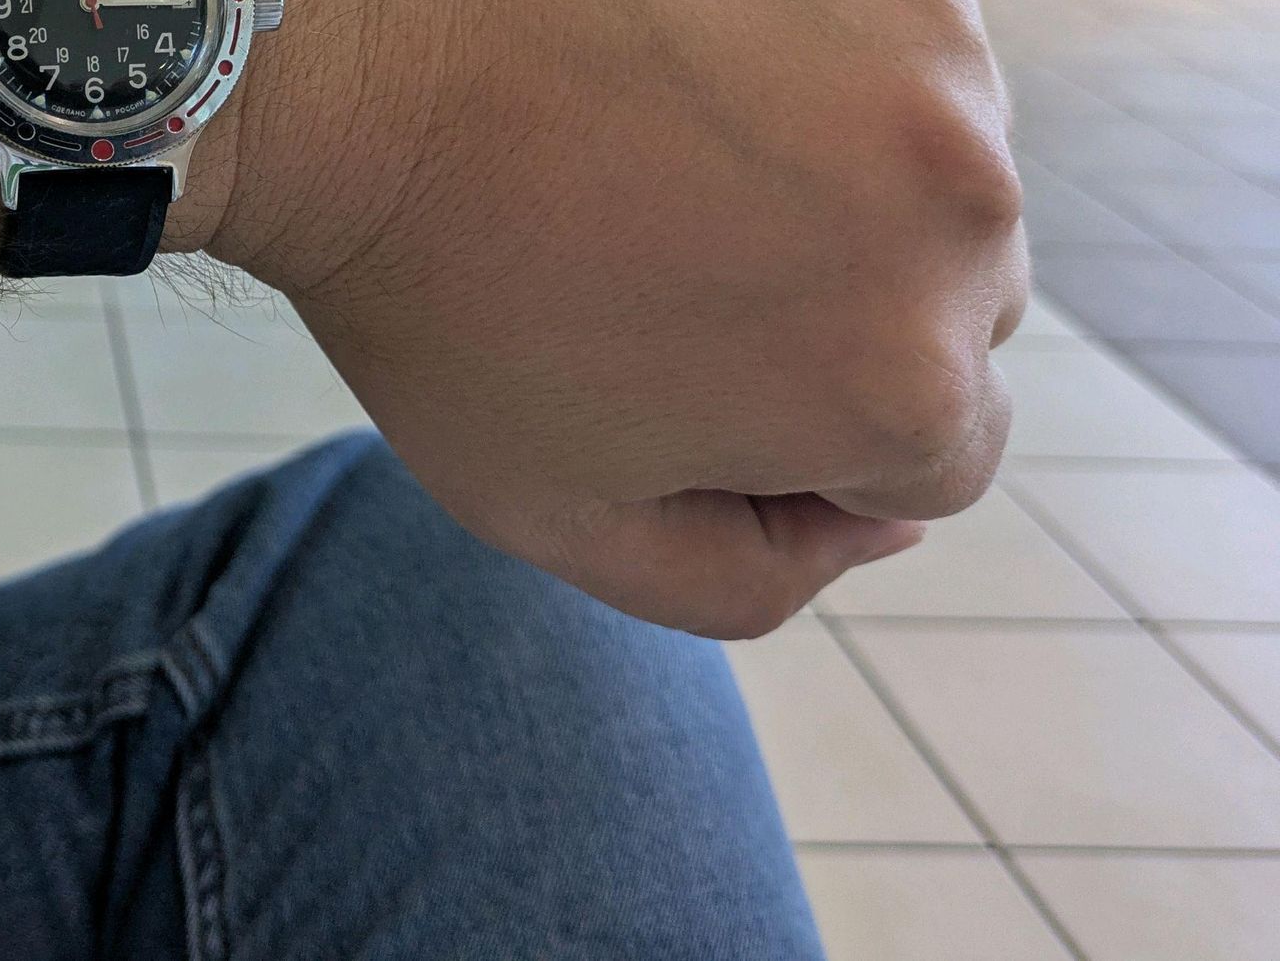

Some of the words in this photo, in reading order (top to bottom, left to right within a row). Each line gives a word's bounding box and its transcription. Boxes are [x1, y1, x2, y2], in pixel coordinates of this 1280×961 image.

[28, 27, 48, 44] 20
[136, 23, 150, 40] 16
[7, 35, 28, 61] 8
[154, 32, 176, 57] 4
[56, 47, 70, 63] 19
[117, 46, 130, 63] 17
[86, 55, 100, 73] 18
[39, 65, 60, 91] 7
[128, 63, 148, 89] 5
[84, 77, 105, 104] 6
[115, 99, 145, 115] РОССИИ
